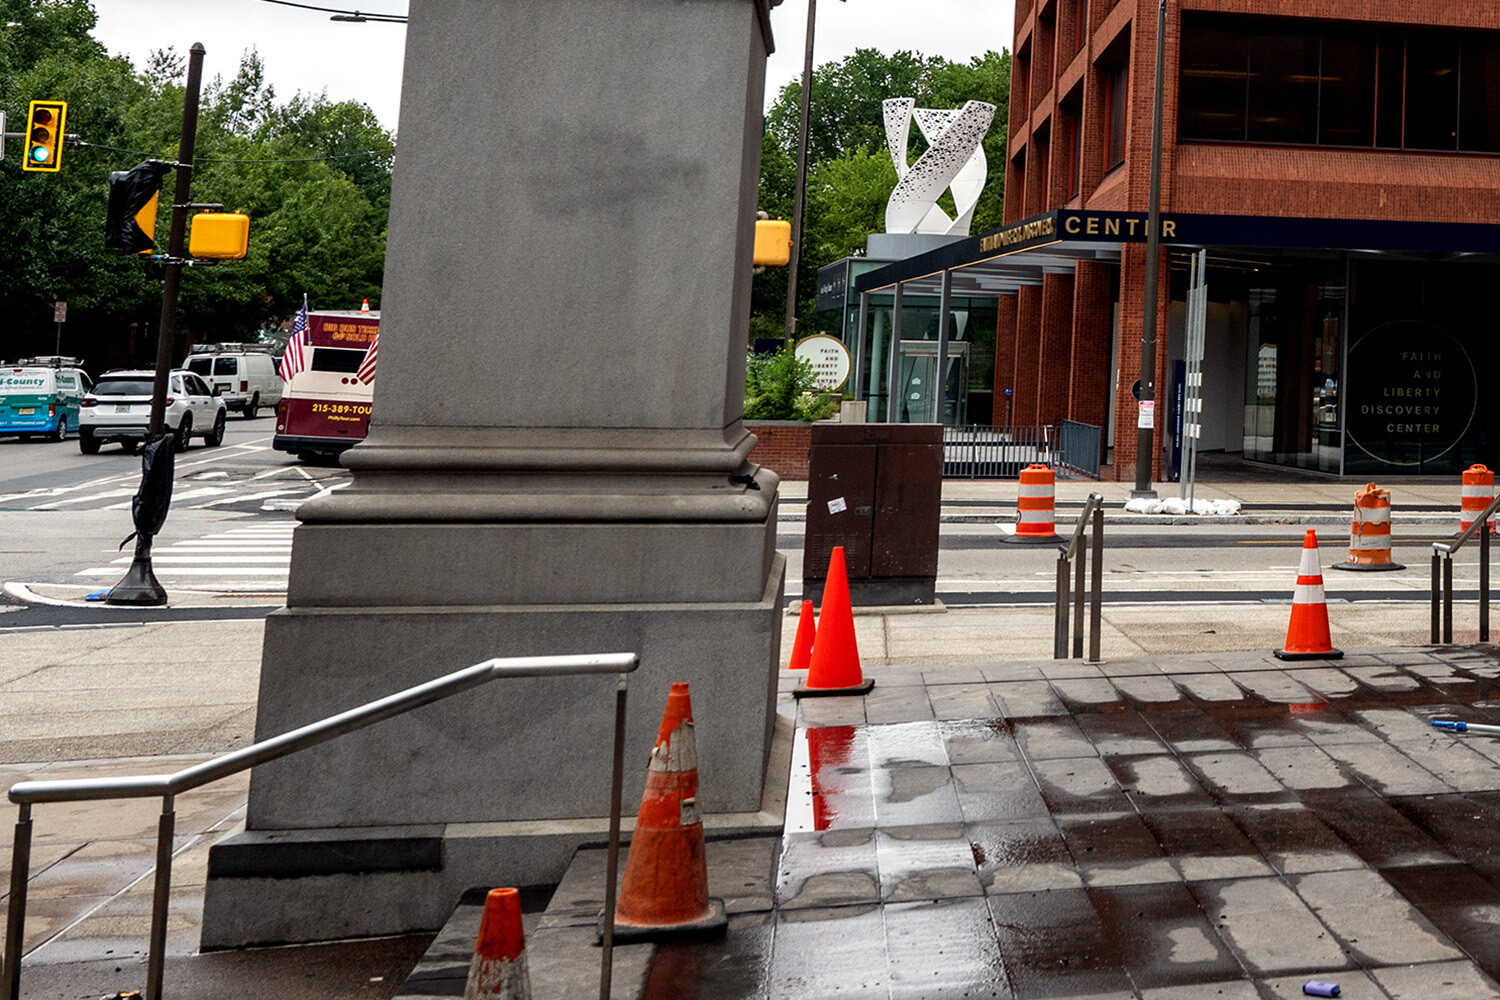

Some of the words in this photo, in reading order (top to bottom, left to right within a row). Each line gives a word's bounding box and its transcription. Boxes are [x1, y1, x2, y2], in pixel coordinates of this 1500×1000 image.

[1064, 216, 1176, 238] CENTR
[1402, 352, 1441, 360] FAITH
[1413, 370, 1441, 379] AND
[1384, 388, 1440, 397] LIBERTY
[1361, 405, 1440, 415] DISCOVERY
[1386, 424, 1440, 433] CENTER
